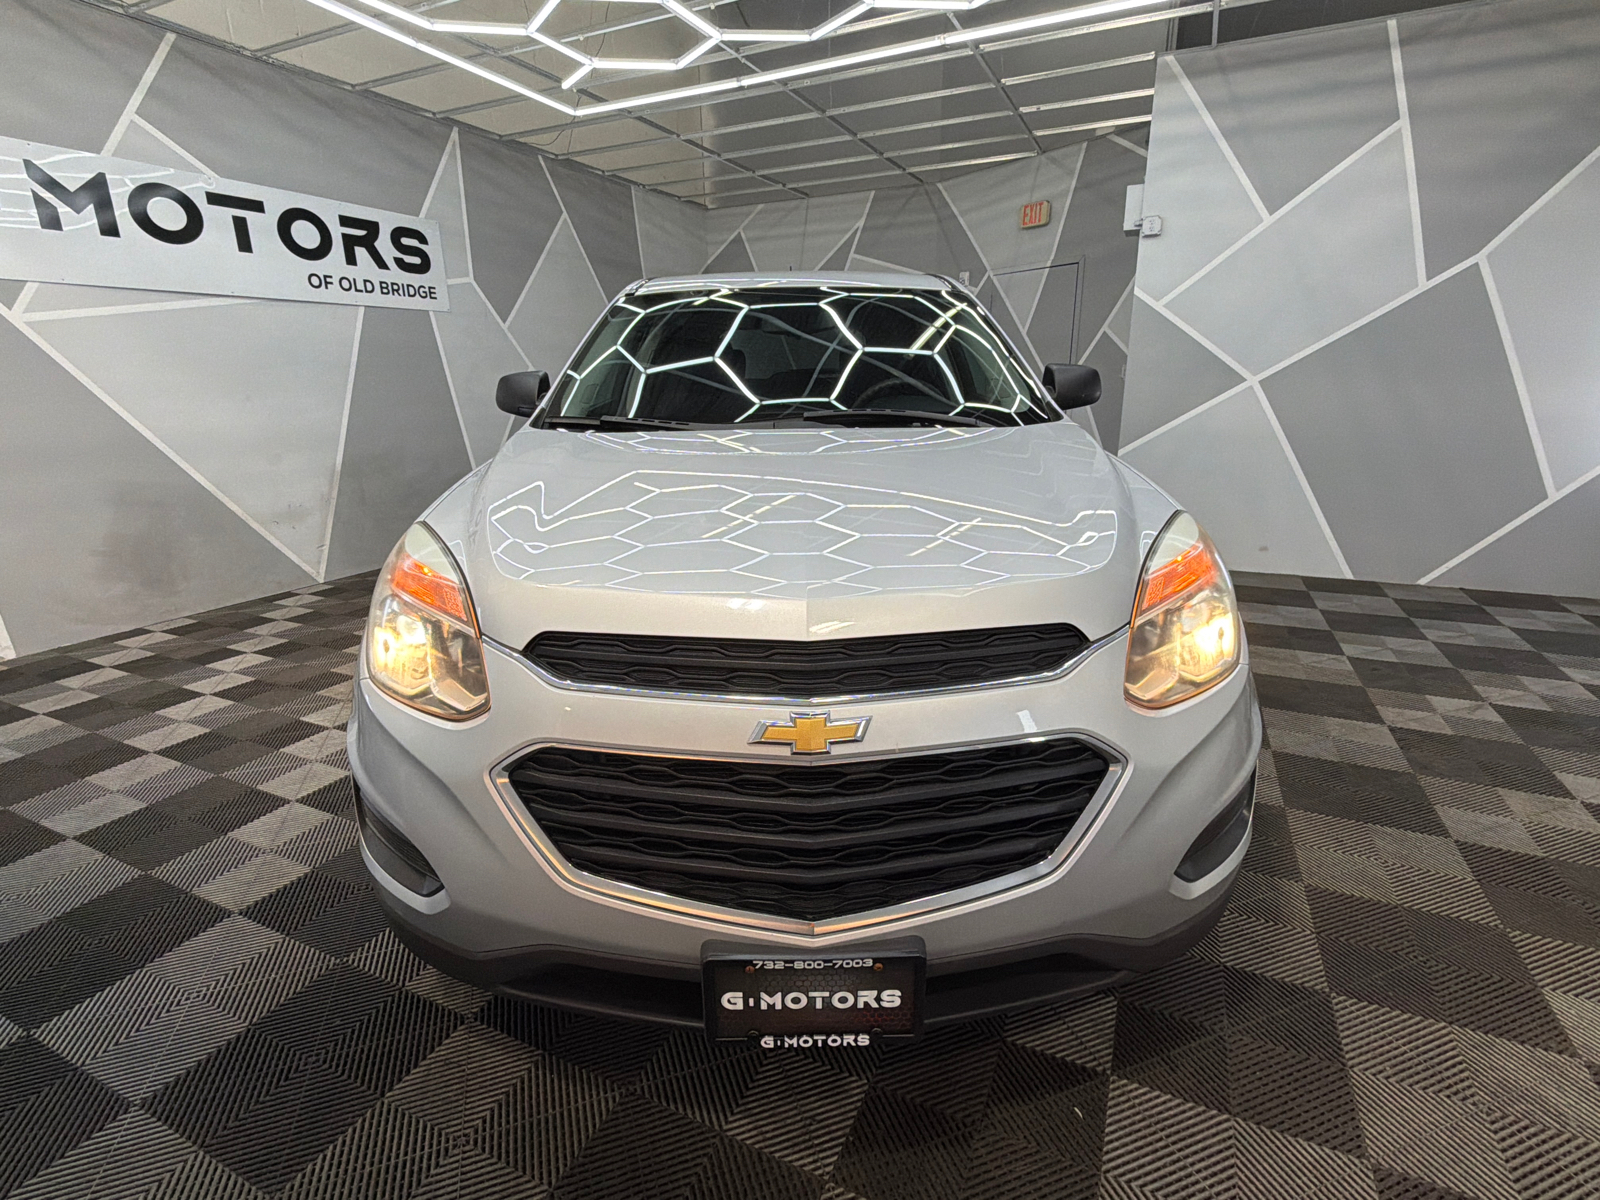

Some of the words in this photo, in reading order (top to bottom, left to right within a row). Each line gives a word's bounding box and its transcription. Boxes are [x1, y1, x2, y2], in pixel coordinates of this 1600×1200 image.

[22, 158, 432, 275] MOTORS
[1022, 201, 1044, 226] EXIT
[307, 273, 334, 290] OF
[338, 276, 375, 294] OLD
[379, 280, 438, 300] BRIDGE
[752, 958, 873, 970] 732-800-7003
